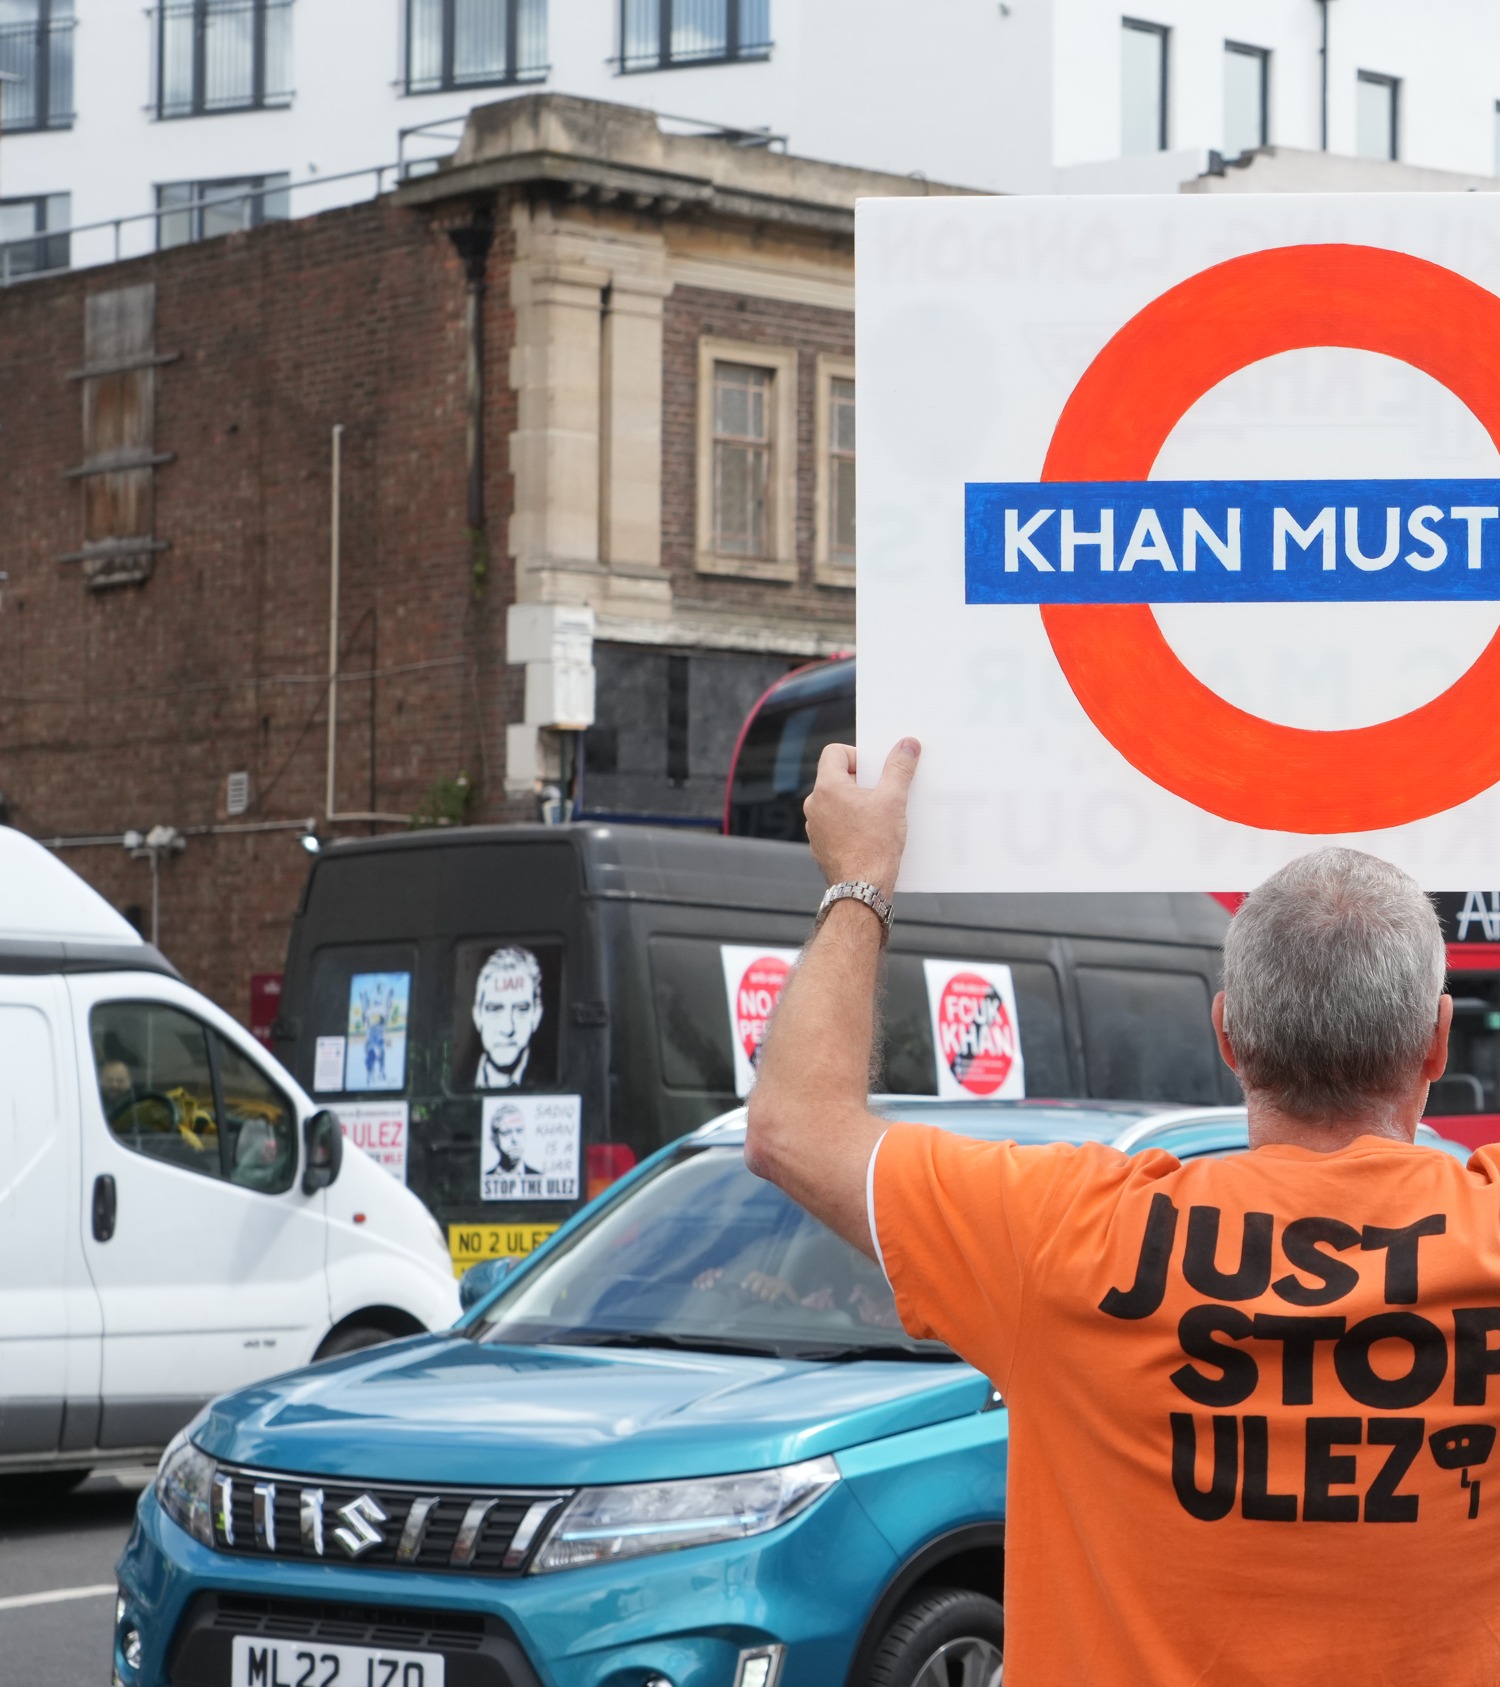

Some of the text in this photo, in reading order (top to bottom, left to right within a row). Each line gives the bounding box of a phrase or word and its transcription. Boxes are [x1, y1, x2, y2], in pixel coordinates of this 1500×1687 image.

[1004, 507, 1242, 574] KHAN
[1272, 505, 1500, 572] MUST
[494, 977, 526, 993] LIAR
[740, 989, 772, 1017] NO
[944, 995, 1004, 1026] FCUK
[941, 1022, 1013, 1059] KHAN
[353, 1120, 403, 1149] ULEZ
[484, 1178, 575, 1195] STOP THE ULEZ
[459, 1231, 482, 1253] NO
[489, 1231, 501, 1253] 2
[1097, 1192, 1447, 1321] JUST
[1168, 1411, 1426, 1524] ULEZ
[248, 1646, 341, 1687] ML22
